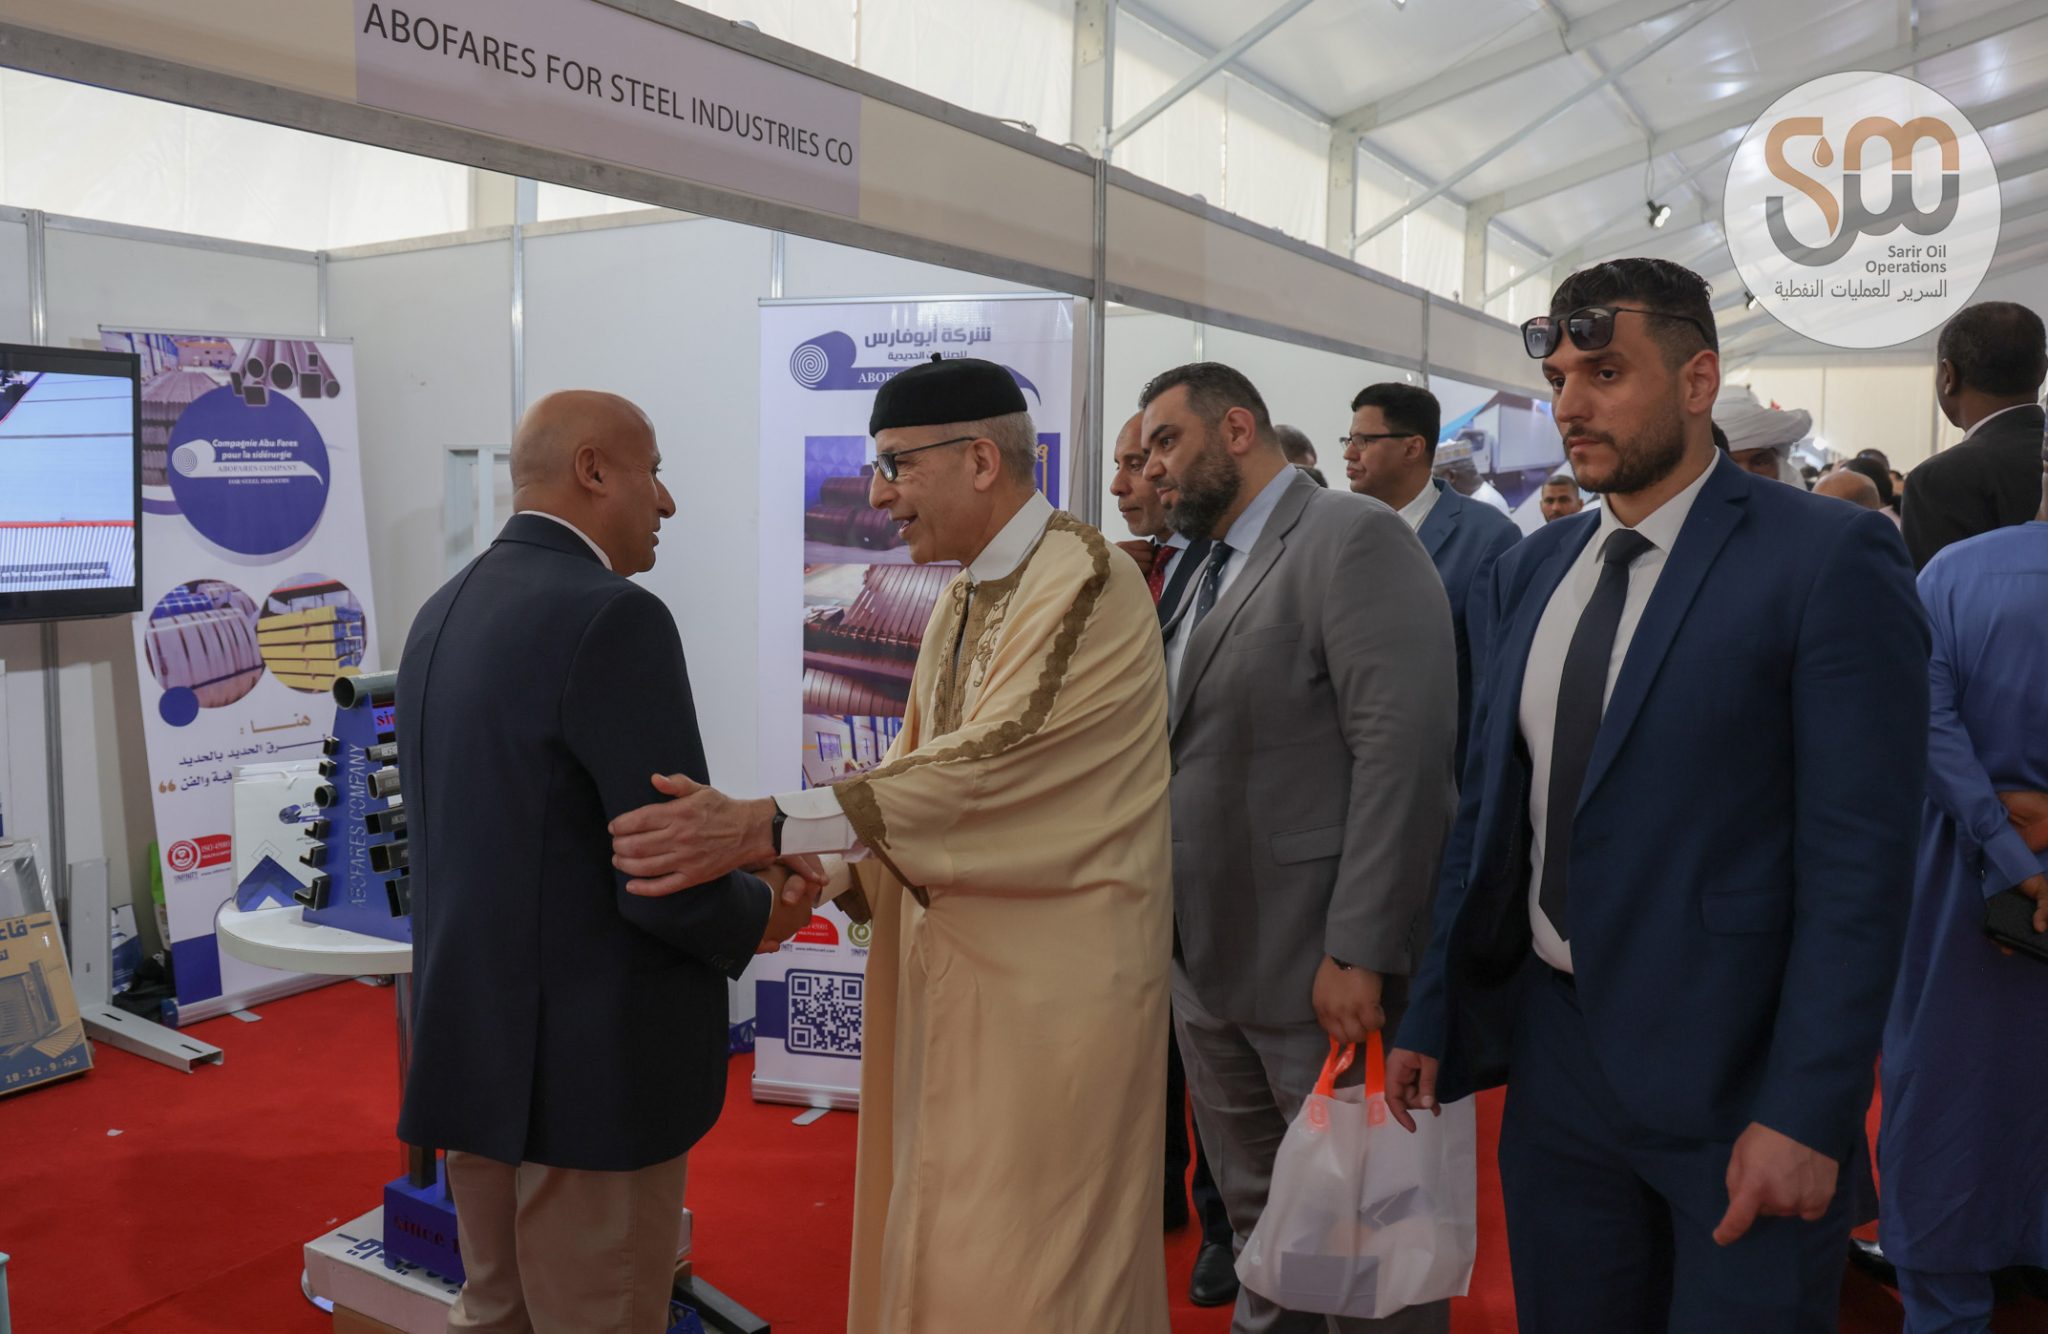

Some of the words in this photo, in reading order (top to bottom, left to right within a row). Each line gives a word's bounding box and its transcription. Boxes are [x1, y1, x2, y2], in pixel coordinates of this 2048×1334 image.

[363, 3, 537, 78] ABOFARES
[546, 54, 602, 98] FOR
[610, 75, 684, 121] STEEL
[692, 97, 819, 157] INDUSTRIES
[825, 137, 853, 167] CO
[942, 327, 991, 346] شركة
[888, 351, 925, 361] الحديدية
[212, 438, 257, 449] Compagnie
[258, 438, 275, 447] Abu
[276, 438, 299, 447] Fares
[221, 452, 241, 460] pour
[242, 450, 251, 459] la
[178, 750, 224, 766] بالحديد
[227, 743, 263, 759] الحديد
[349, 744, 366, 820] COMPANY
